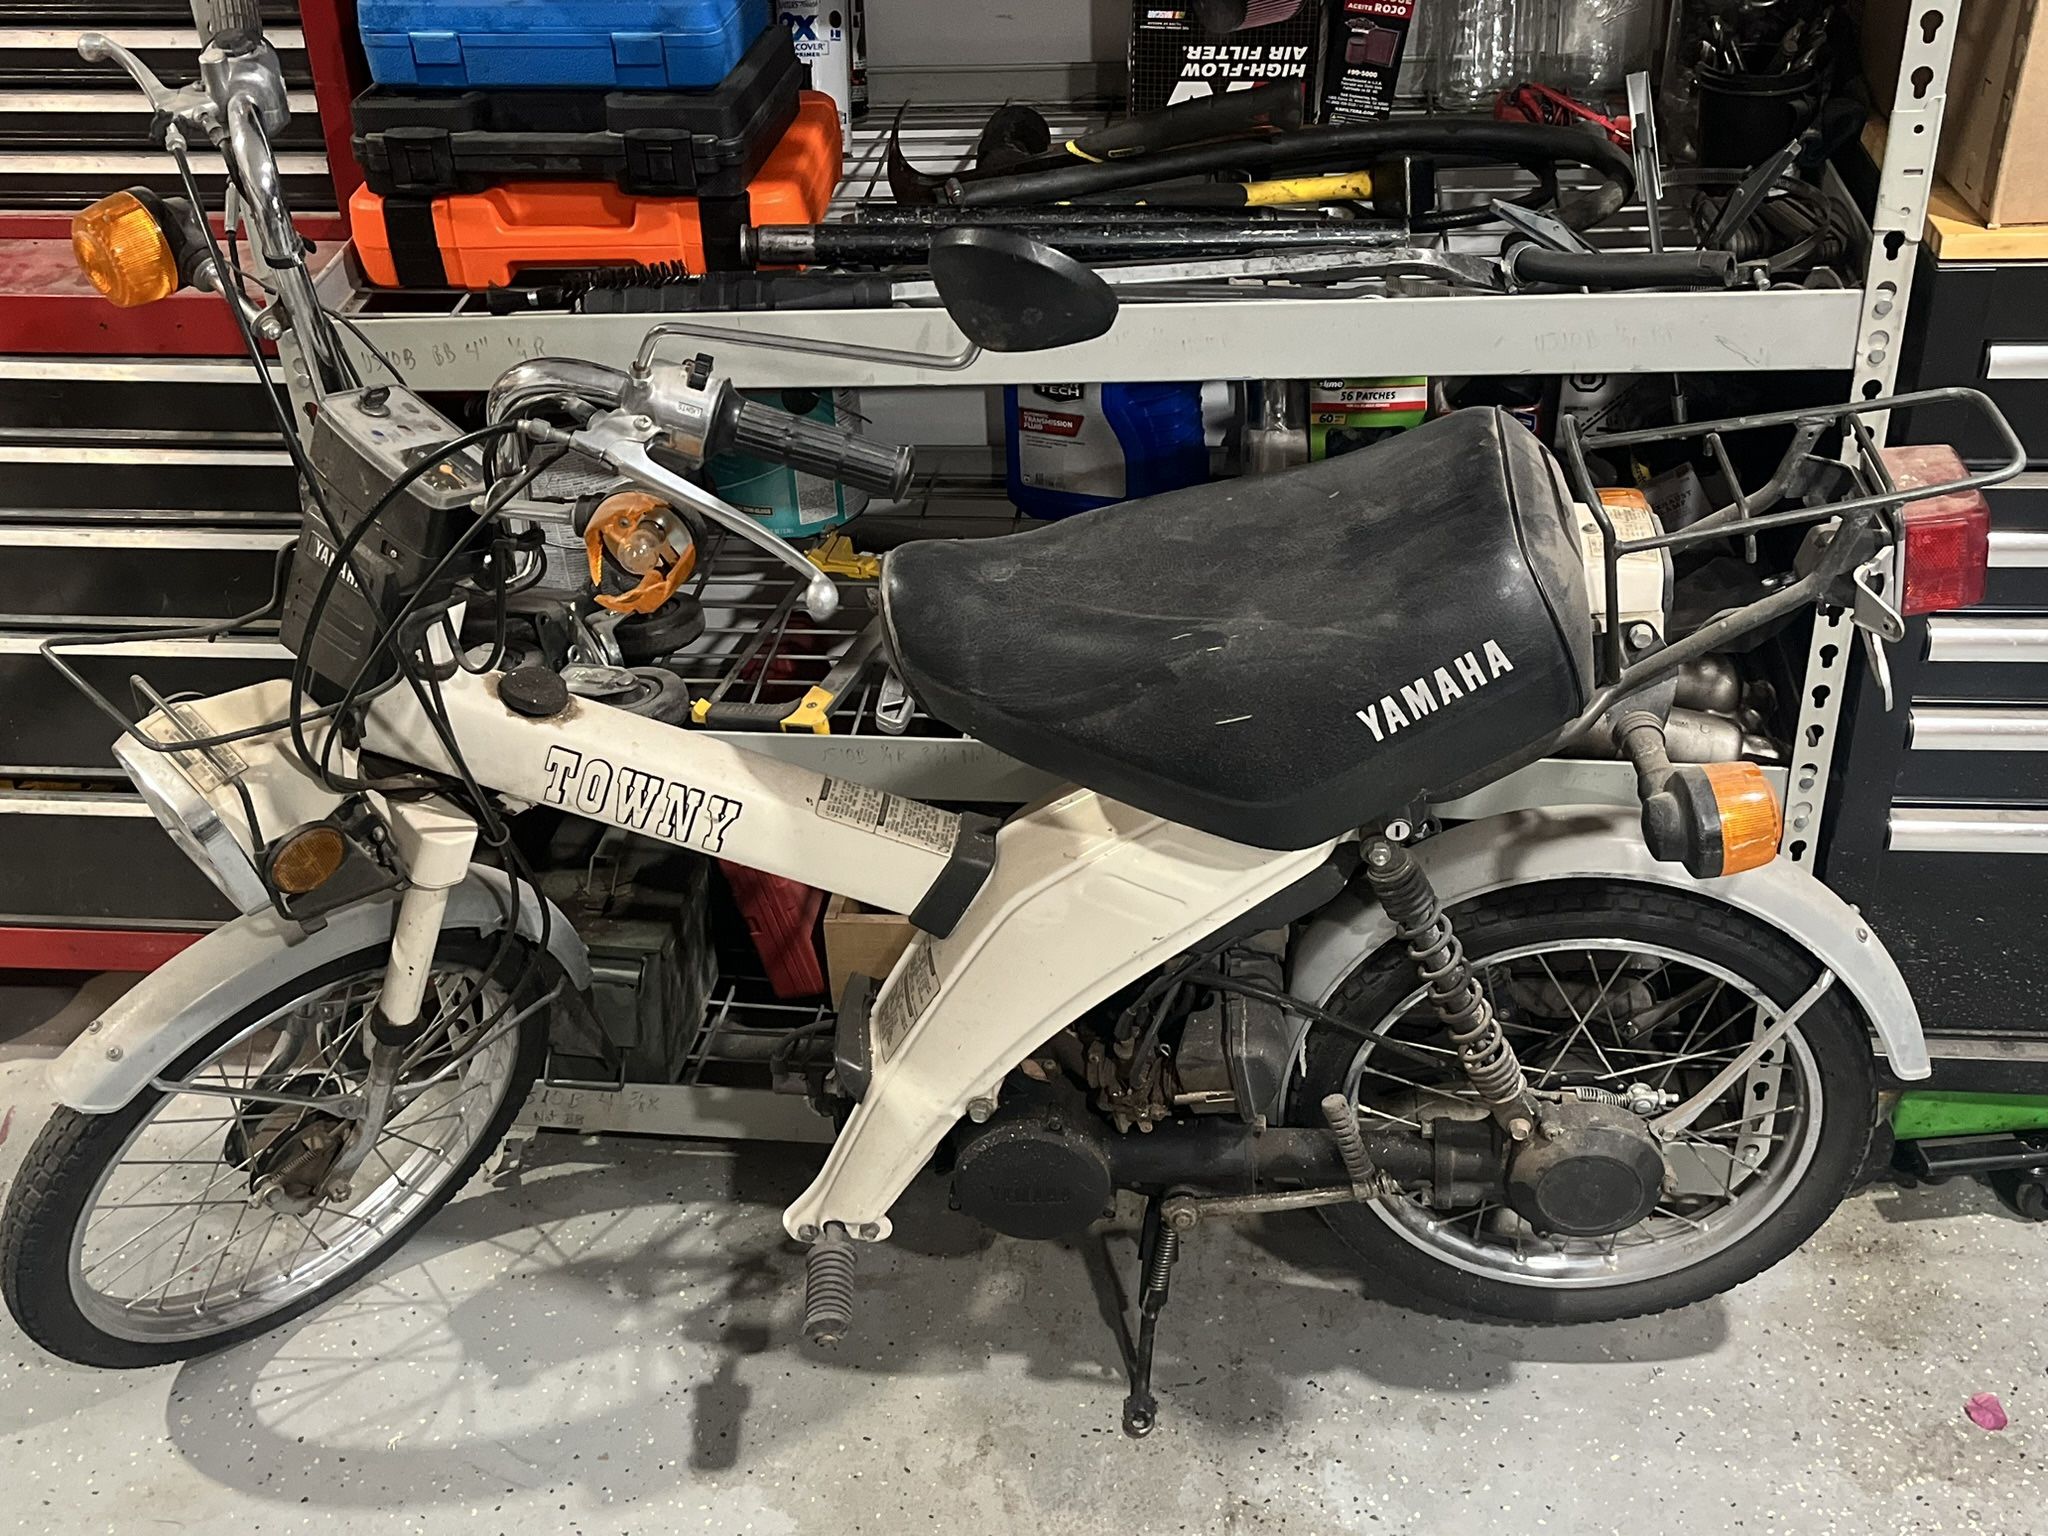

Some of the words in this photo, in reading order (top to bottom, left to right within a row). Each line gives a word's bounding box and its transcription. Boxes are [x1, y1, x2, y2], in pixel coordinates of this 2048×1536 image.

[1347, 3, 1373, 11] ACEITE
[1374, 3, 1407, 16] ROJO
[1268, 46, 1308, 61] AIR
[1180, 63, 1306, 78] HIGH-FLOW
[1041, 385, 1080, 397] TECH
[1341, 391, 1353, 401] 56
[1355, 391, 1396, 400] PATCHES
[1320, 414, 1334, 423] 60
[1355, 639, 1514, 742] YAMAHA
[544, 744, 743, 853] TOWNY
